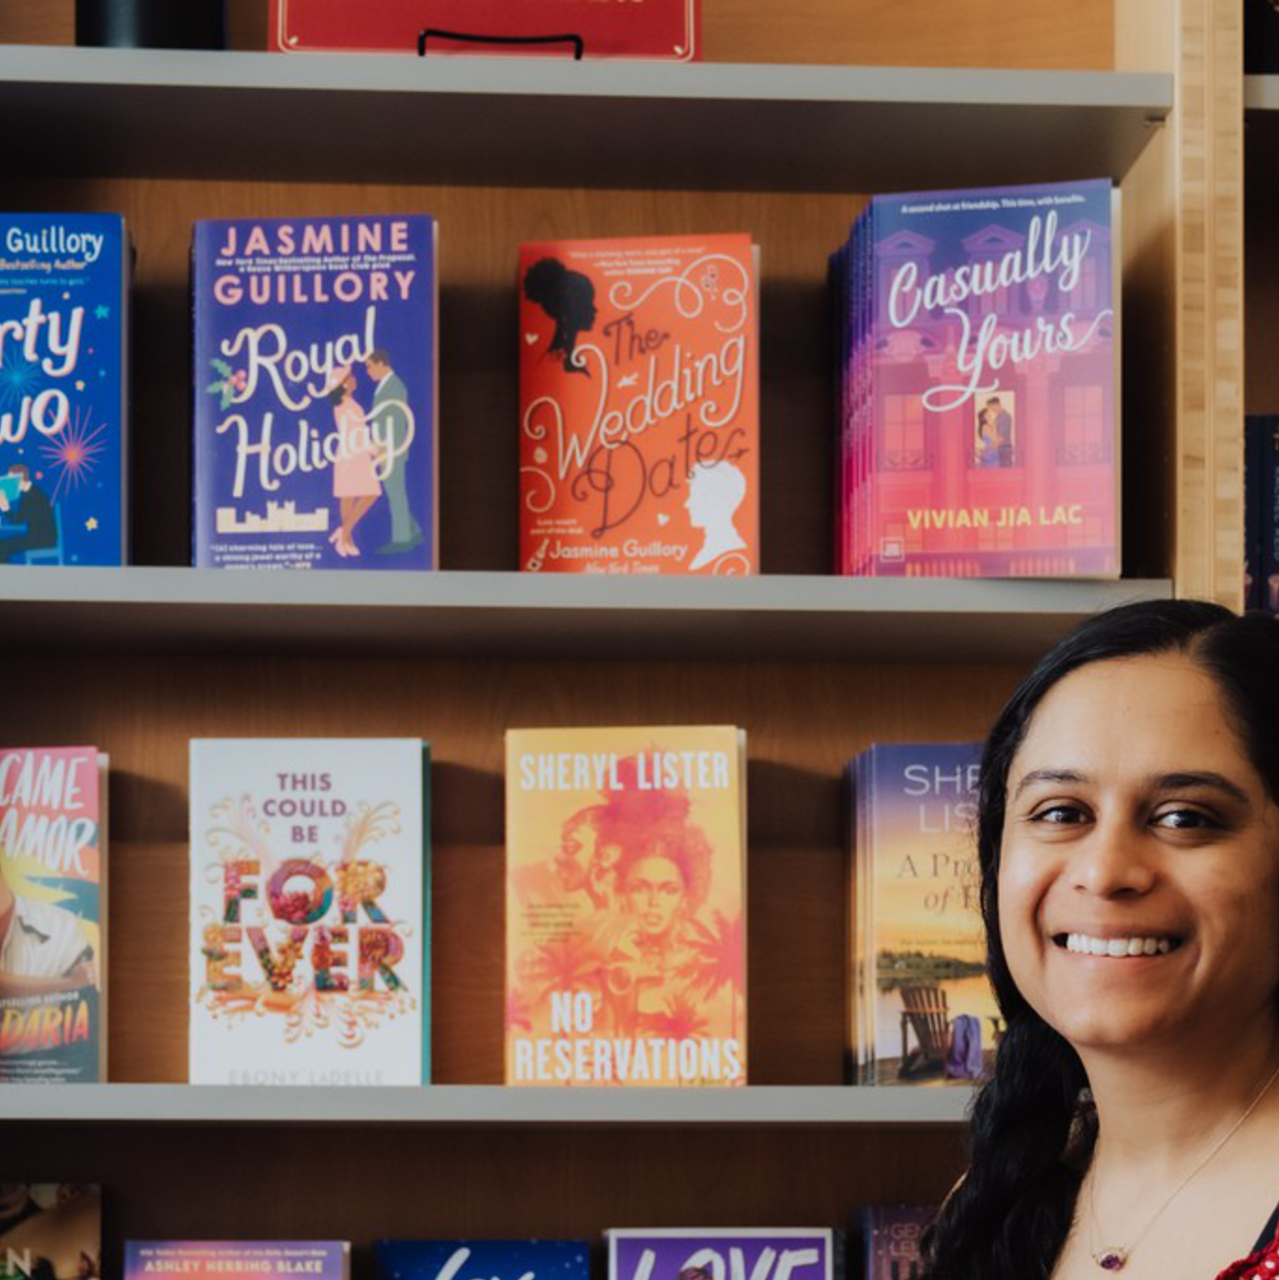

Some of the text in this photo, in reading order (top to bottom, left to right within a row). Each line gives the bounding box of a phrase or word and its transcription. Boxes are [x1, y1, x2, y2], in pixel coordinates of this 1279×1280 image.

[6, 226, 103, 262] Guillory
[220, 222, 409, 257] JASMINE
[213, 270, 416, 306] GUILLORY
[888, 209, 1092, 329] Casually
[220, 305, 376, 411] Royal
[604, 312, 671, 366] The
[922, 308, 1114, 412] Yours
[524, 334, 746, 481] Wedding
[216, 399, 415, 498] Holiday
[907, 504, 1083, 529] VIVIAN JIA LAC
[549, 539, 689, 561] Jasmine Guillory
[276, 773, 332, 791] THIS
[520, 751, 730, 791] SHERYL LISTER
[262, 799, 348, 818] COULD
[291, 826, 319, 843] BE
[223, 857, 393, 926] FOR
[201, 924, 409, 993] EVER
[550, 990, 594, 1034] NO
[515, 1037, 742, 1081] RESERVATIONS
[144, 1260, 324, 1274] ASHLEY BLAKE
